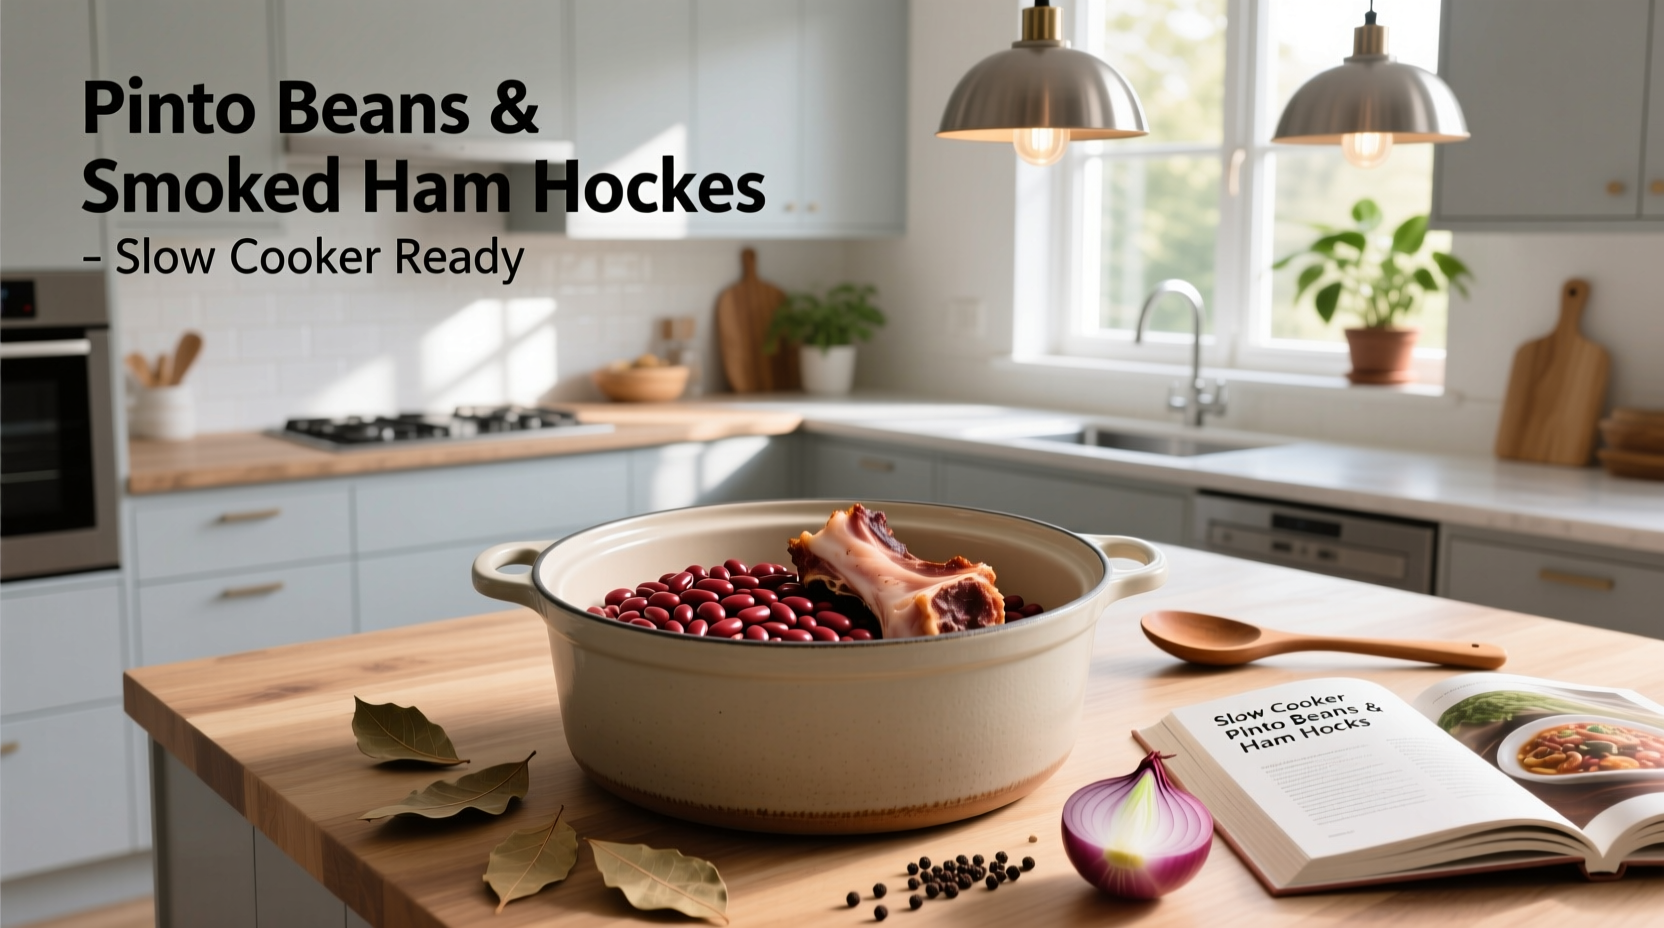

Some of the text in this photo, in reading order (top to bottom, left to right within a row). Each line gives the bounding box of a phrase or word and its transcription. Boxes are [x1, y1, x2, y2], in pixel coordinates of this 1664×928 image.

[1213, 694, 1345, 727] Slow Cooker
[1225, 702, 1384, 740] Pinto Beans &
[1239, 717, 1371, 754] Ham Hocks
